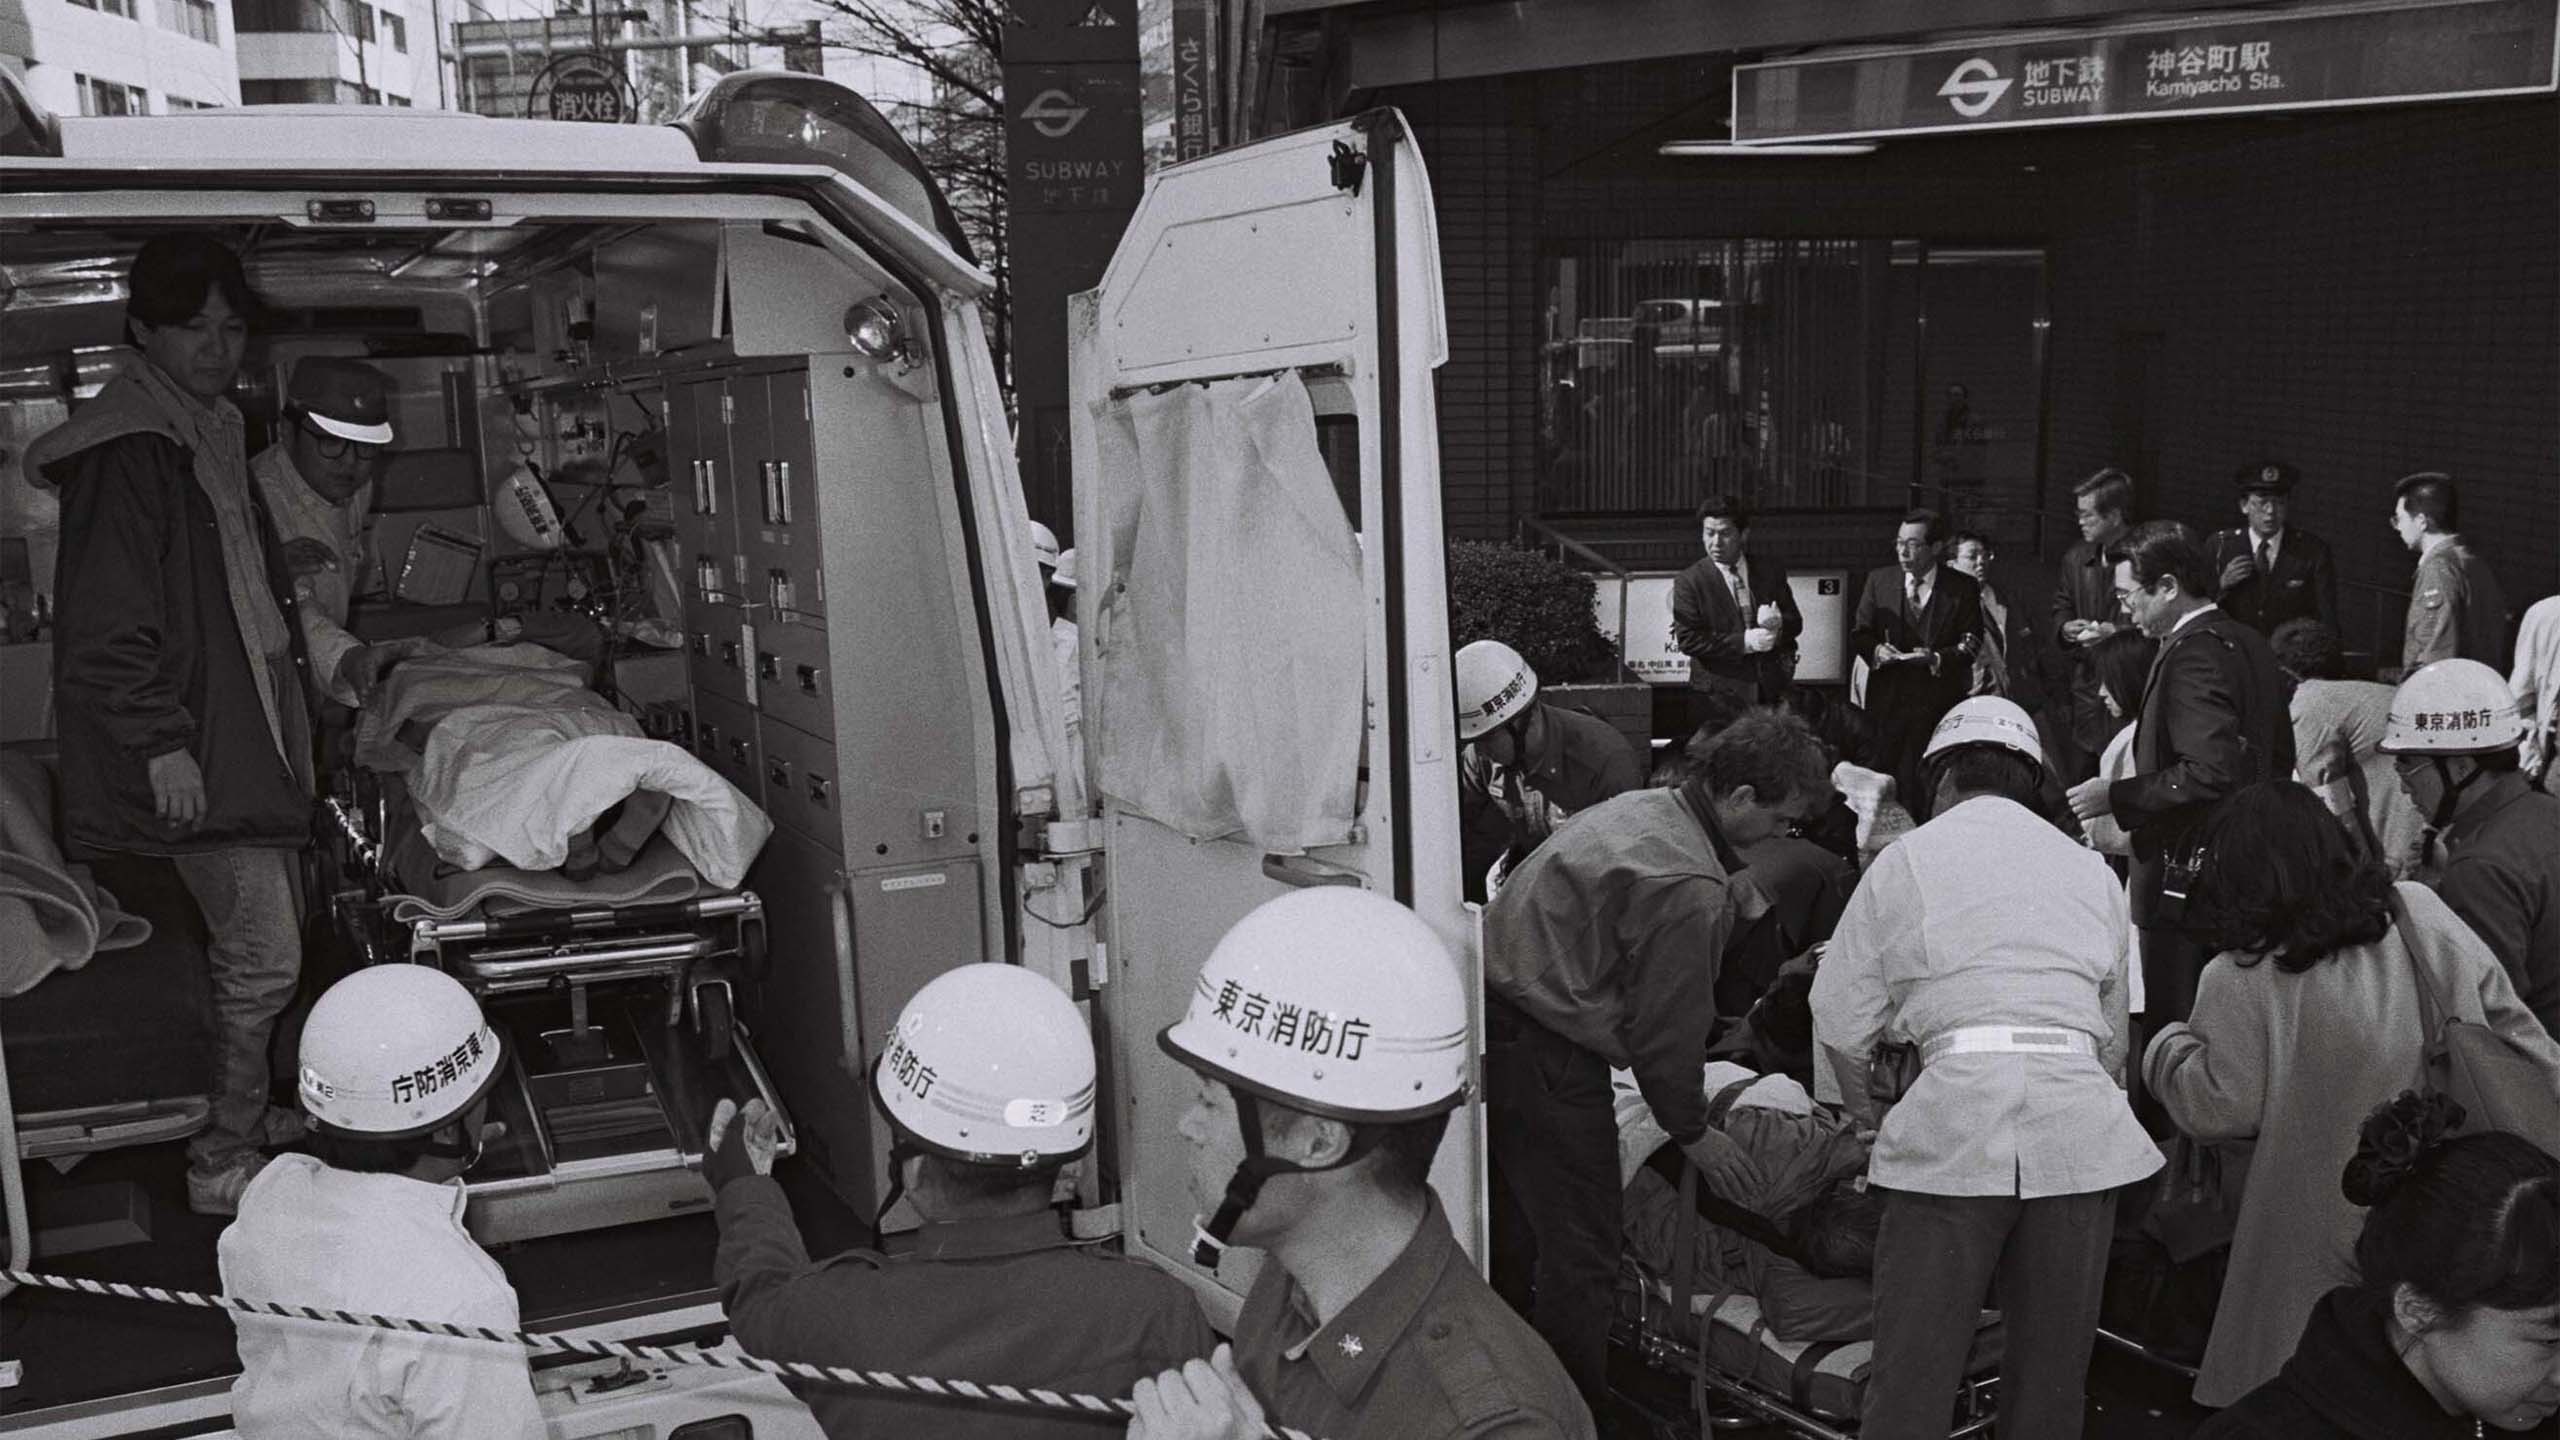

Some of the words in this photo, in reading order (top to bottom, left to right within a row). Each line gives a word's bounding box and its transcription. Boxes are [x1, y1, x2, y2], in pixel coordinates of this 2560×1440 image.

[2023, 56, 2105, 87] 地下鉄
[2147, 41, 2271, 79] 神谷町駅
[2250, 72, 2285, 90] Sta.
[555, 90, 616, 120] 消火栓
[2023, 86, 2102, 106] SUBWAY
[1025, 160, 1124, 181] SUBWAY
[1824, 580, 1834, 594] 3
[1481, 672, 1526, 716] 東京消防庁
[2415, 708, 2492, 732] 東京消防庁
[1212, 979, 1371, 1061] 東京消防庁
